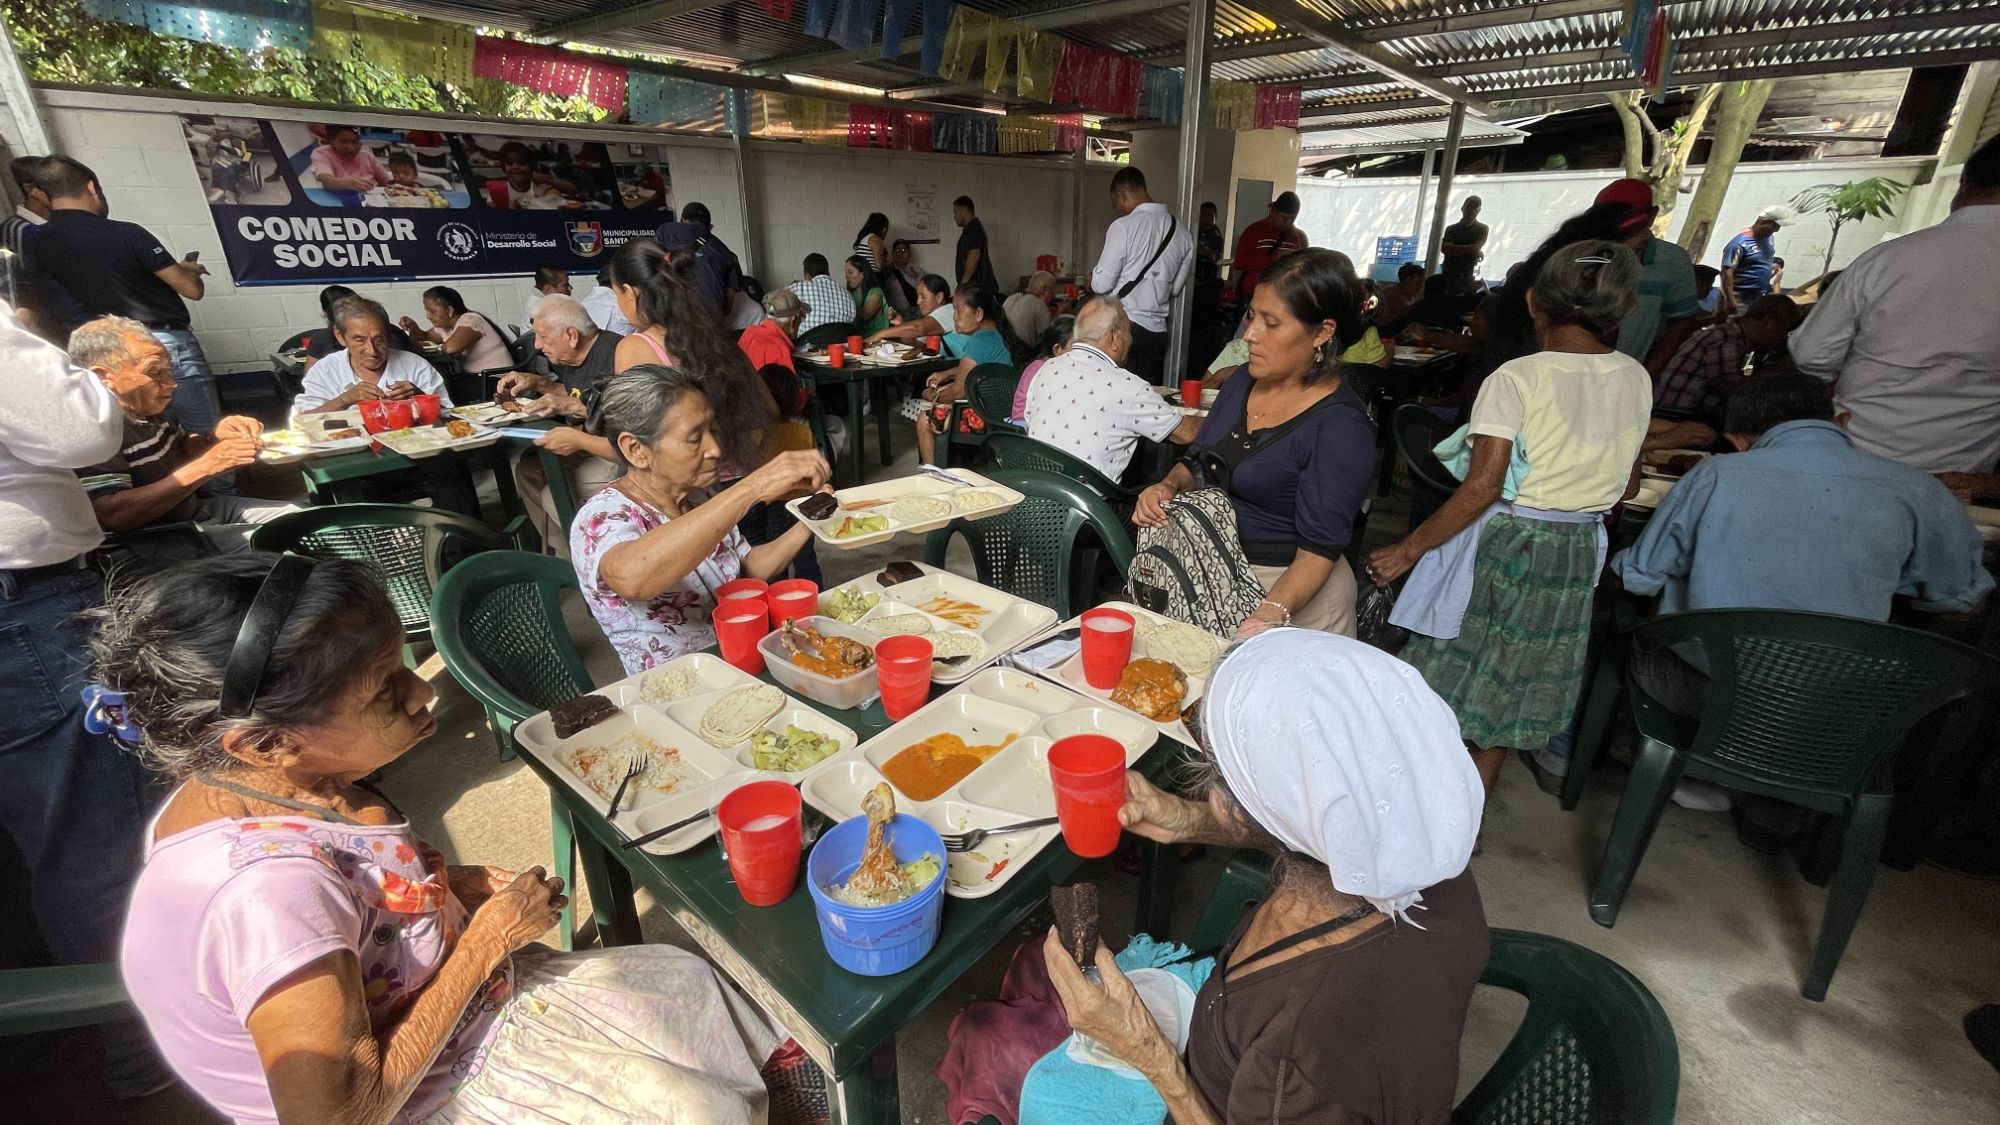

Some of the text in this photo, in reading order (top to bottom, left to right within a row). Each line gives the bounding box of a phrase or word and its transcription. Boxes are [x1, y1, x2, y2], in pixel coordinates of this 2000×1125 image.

[237, 216, 418, 241] COMEDOR
[485, 232, 537, 240] Ministerio de
[487, 239, 557, 248] Desarrollo Social
[273, 243, 402, 268] SOCIAL
